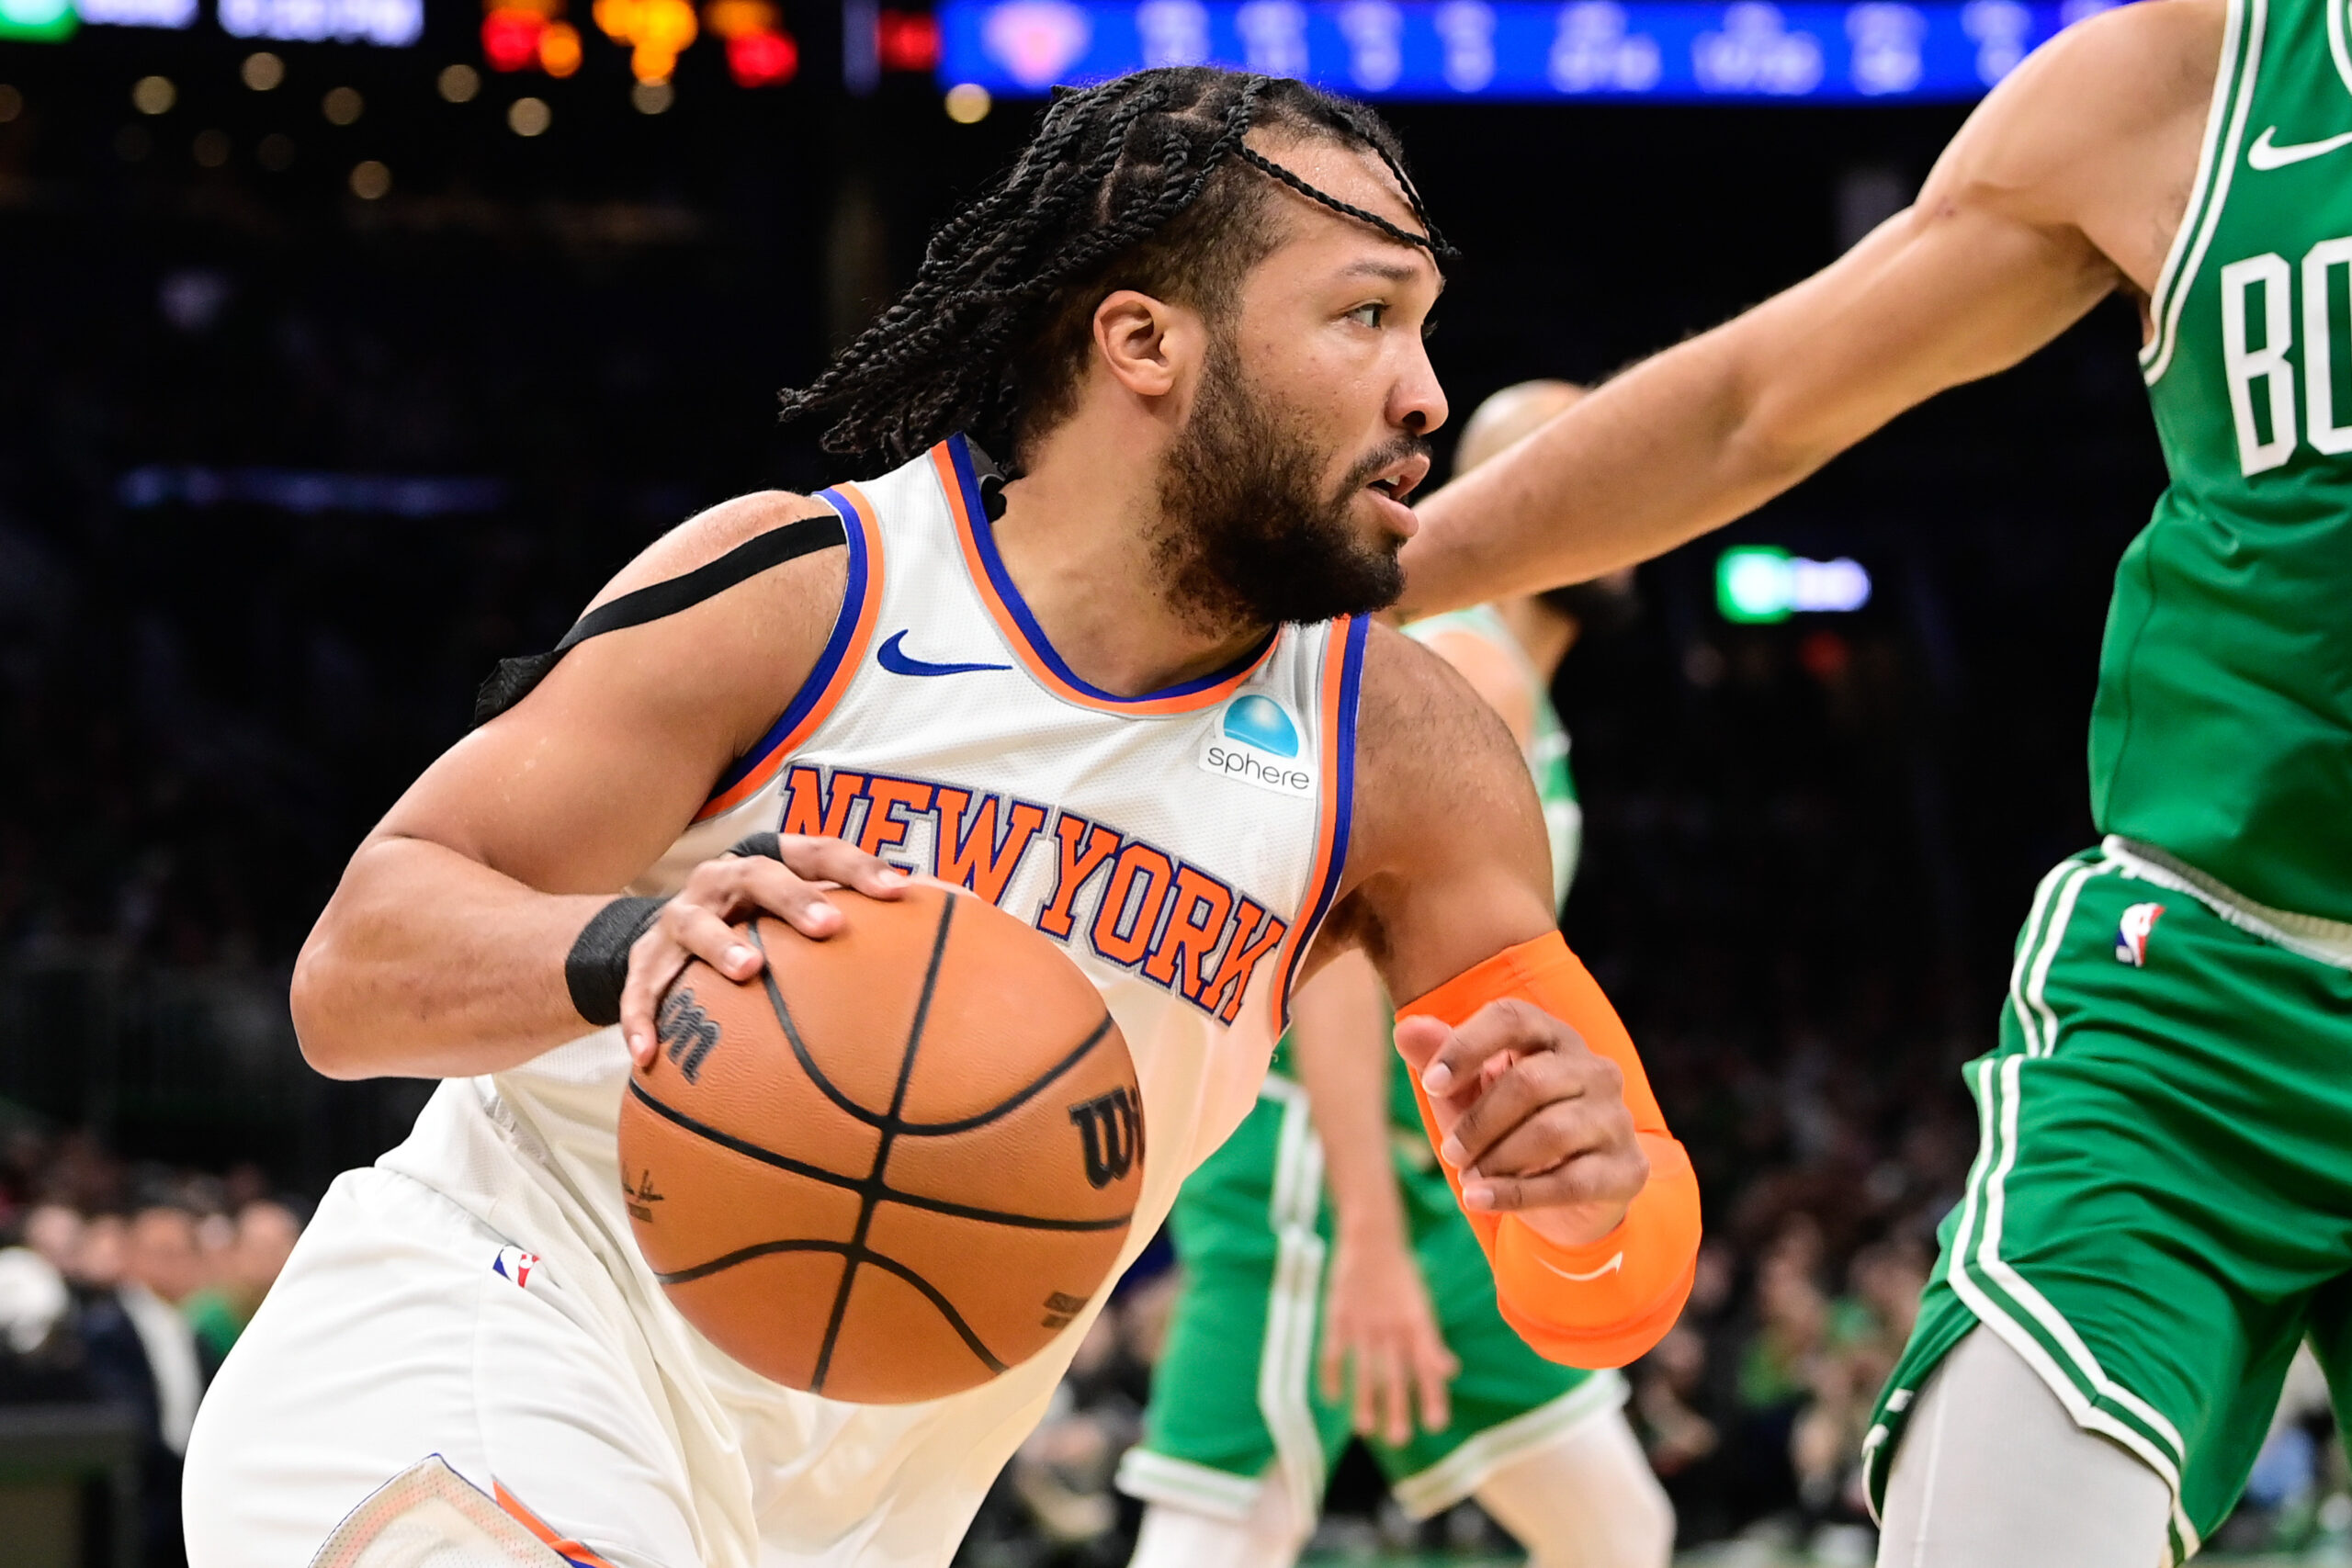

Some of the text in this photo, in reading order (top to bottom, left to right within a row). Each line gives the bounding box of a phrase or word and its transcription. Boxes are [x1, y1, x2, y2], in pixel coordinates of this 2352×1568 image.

[1207, 747, 1310, 790] sphere
[780, 764, 1289, 1028] NEW YORK
